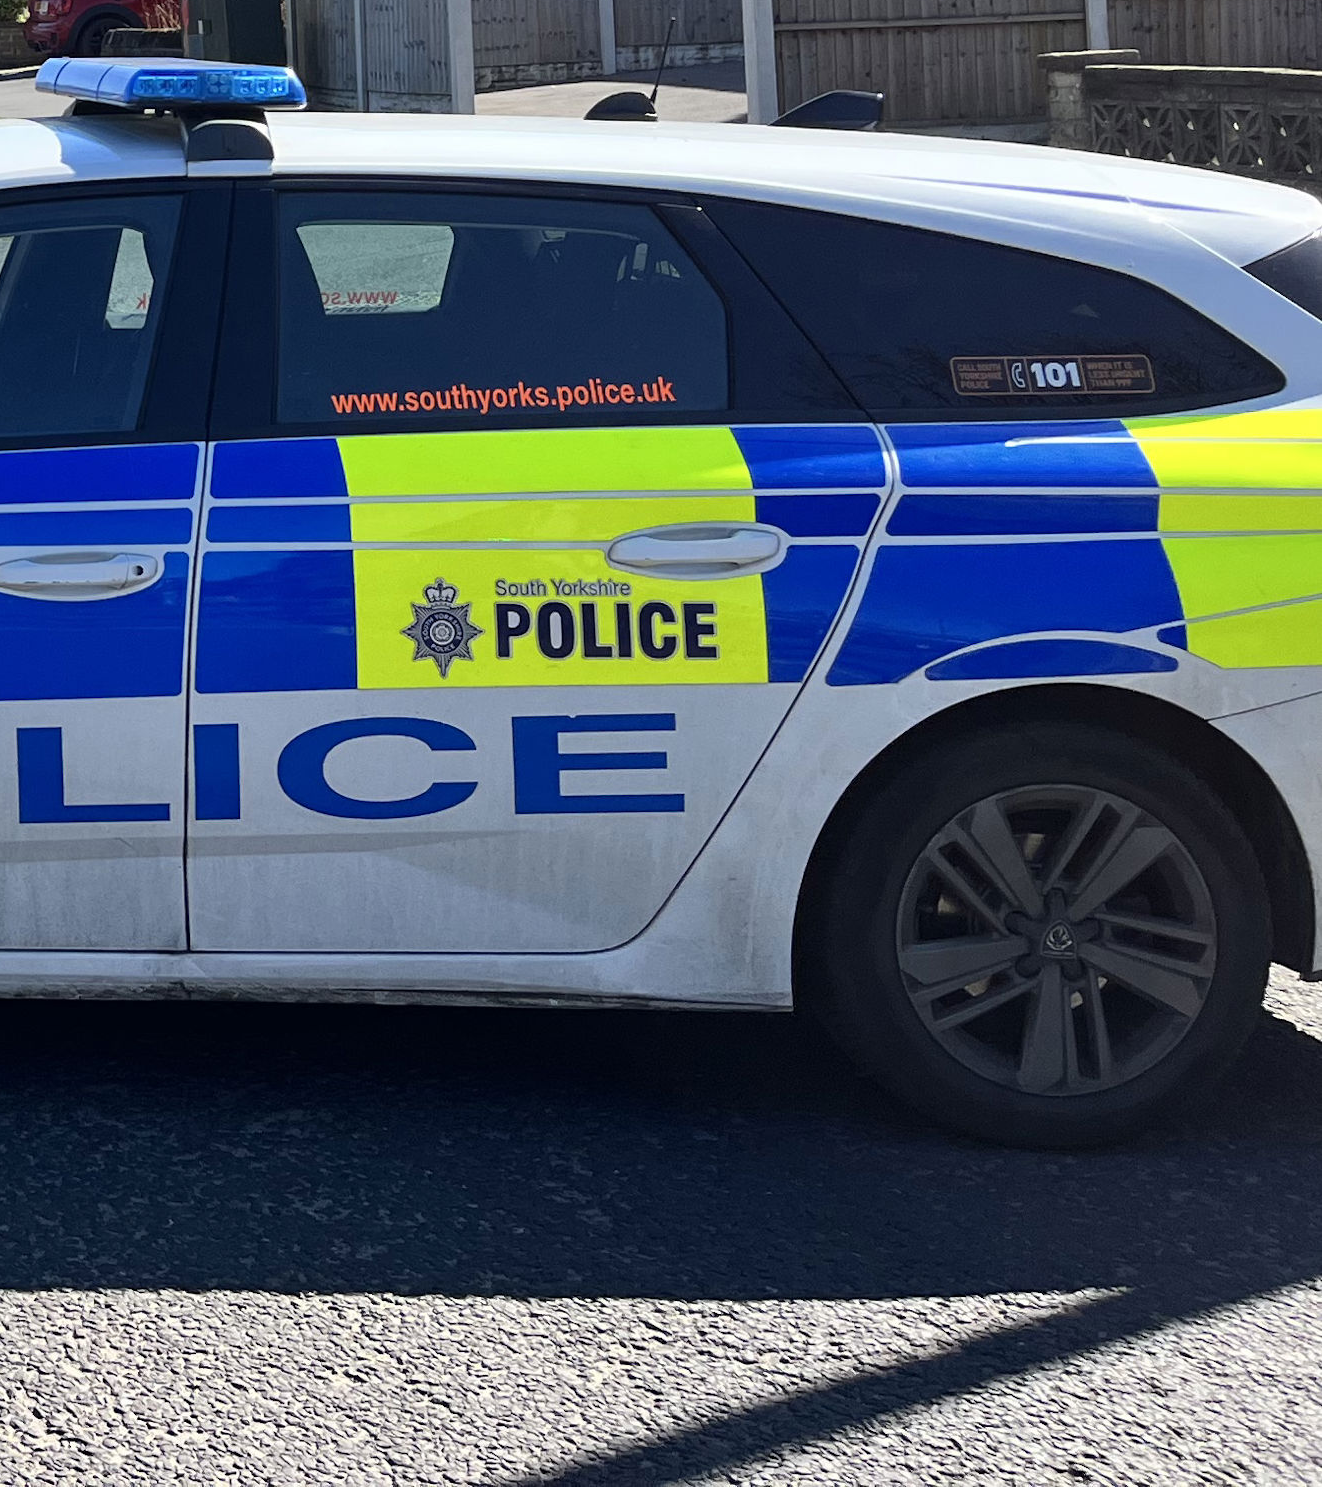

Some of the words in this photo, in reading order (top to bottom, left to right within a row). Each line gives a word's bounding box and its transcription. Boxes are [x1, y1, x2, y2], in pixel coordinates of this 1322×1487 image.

[1030, 362, 1081, 387] 101
[331, 376, 677, 415] www.southyorks.police.uk
[495, 579, 547, 596] South
[551, 579, 632, 596] Yorkshire
[495, 601, 718, 660] POLICE
